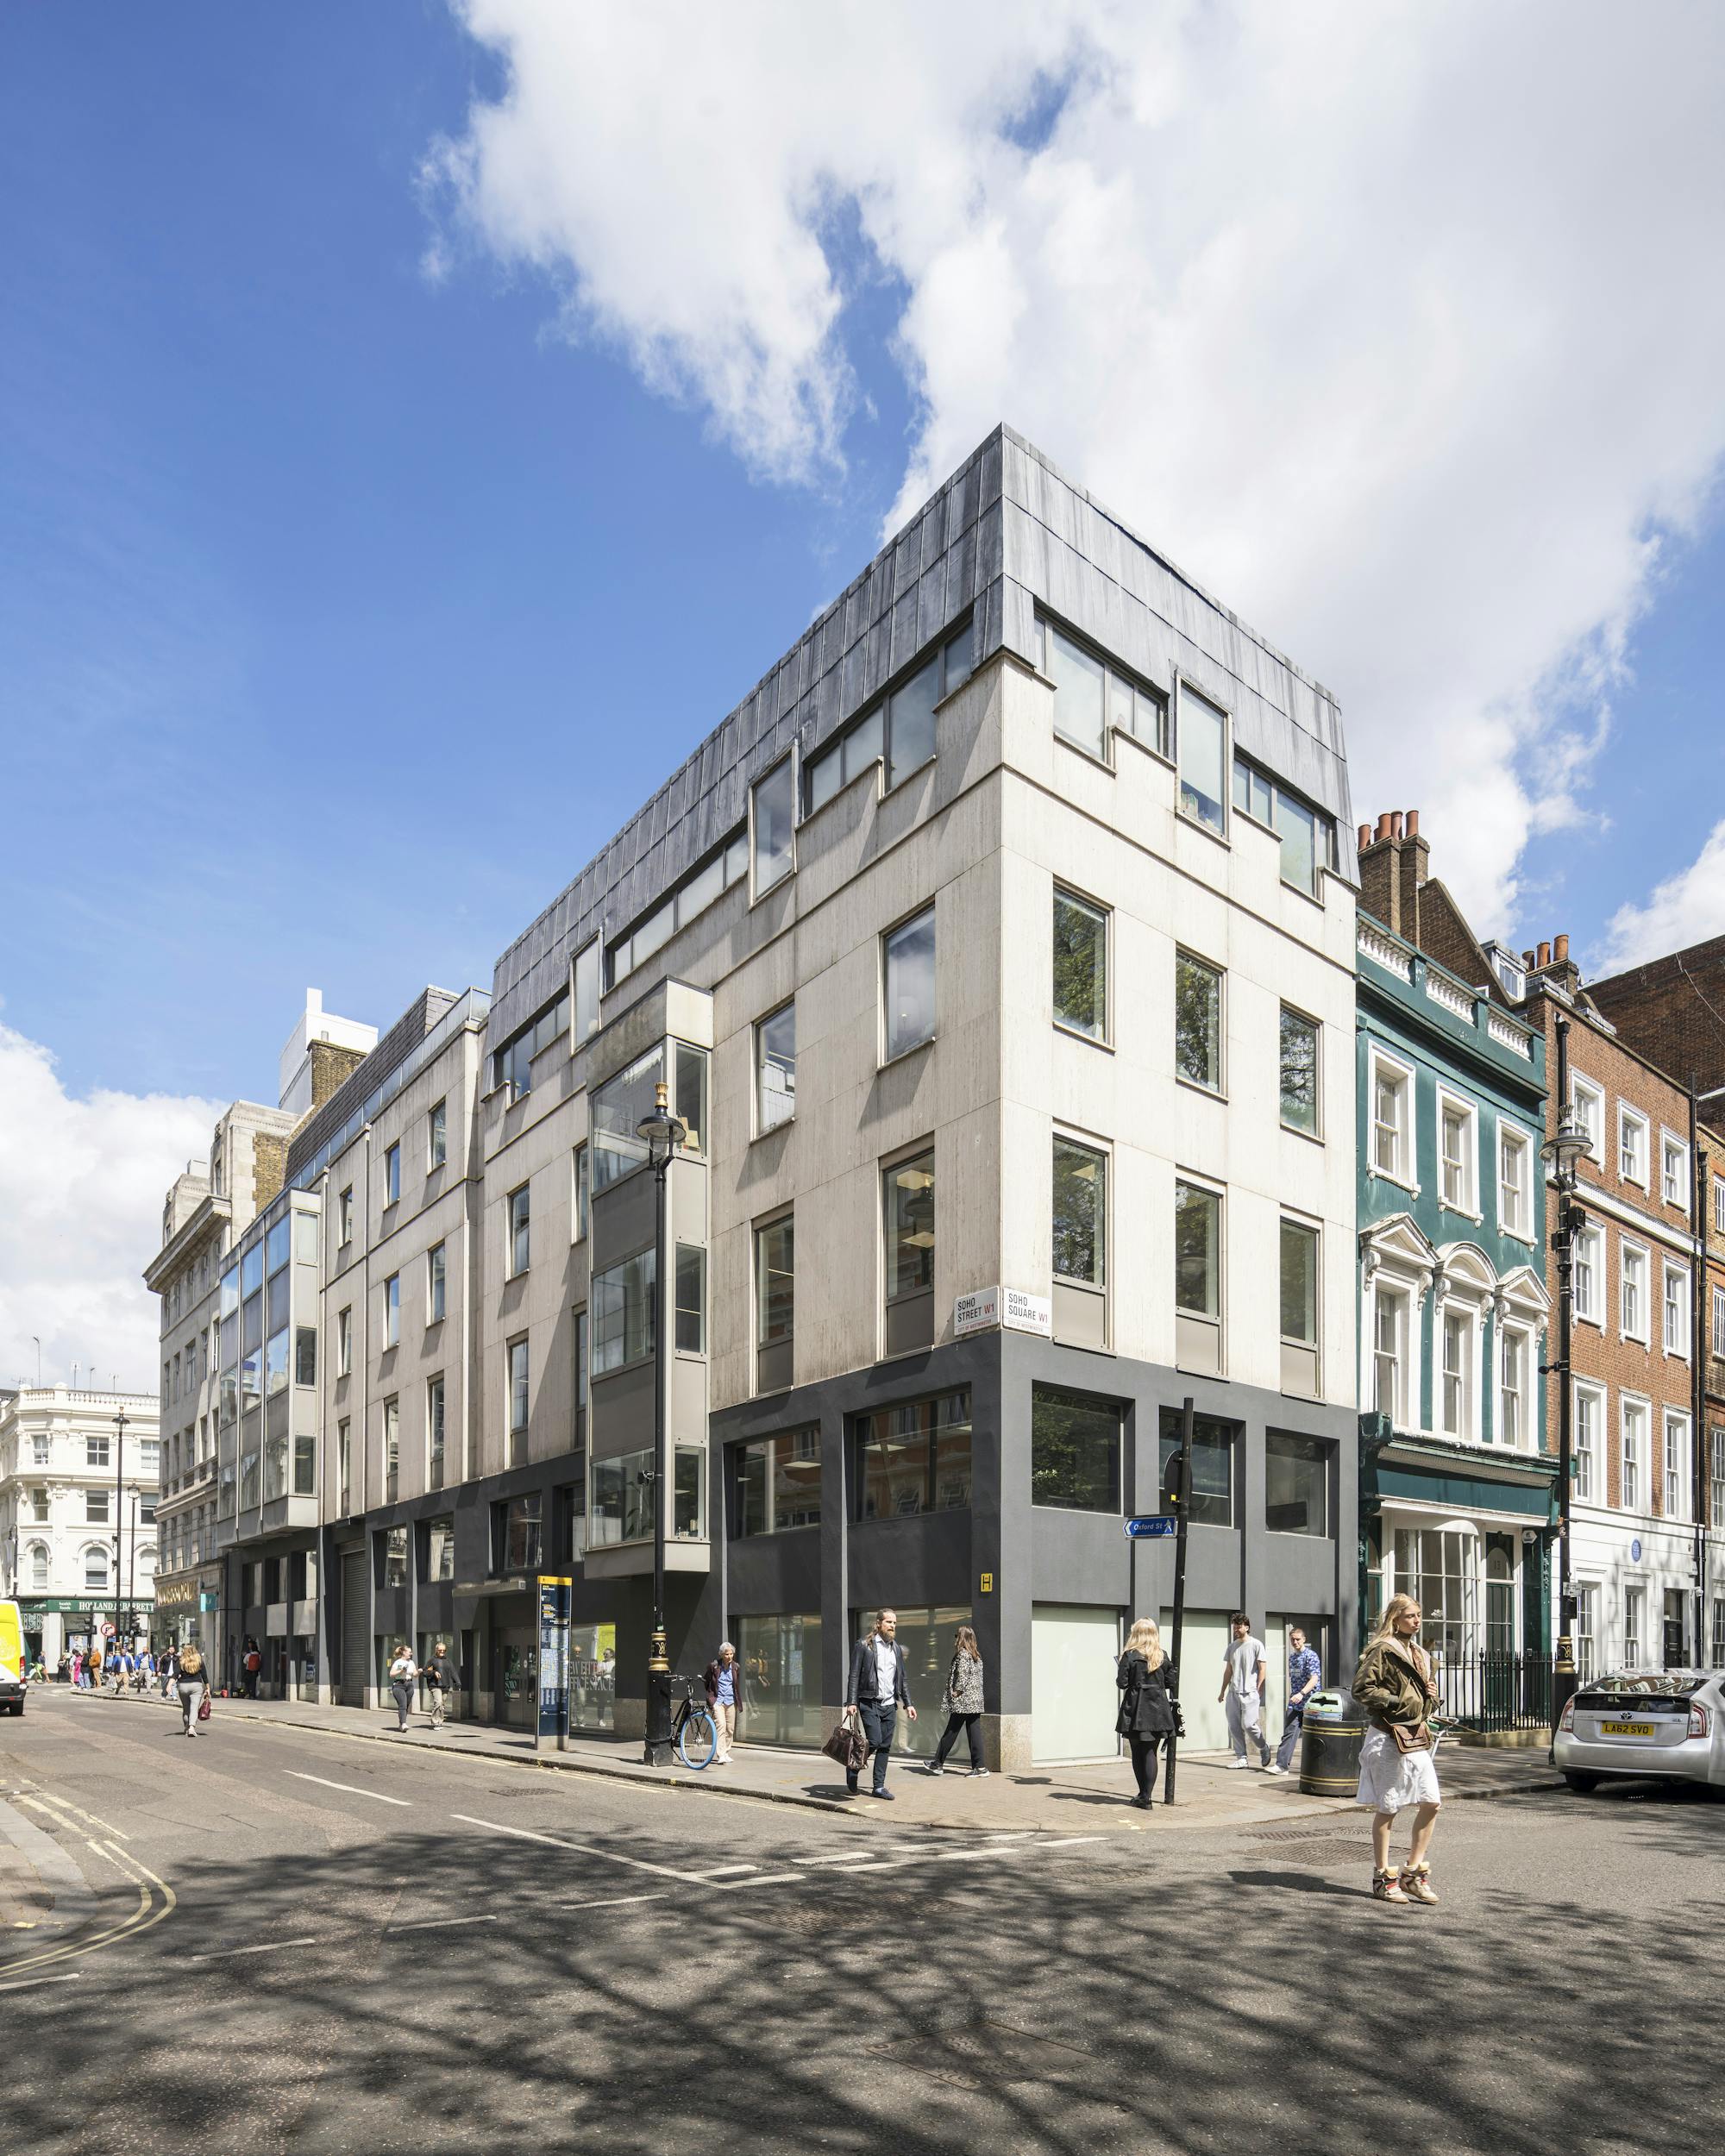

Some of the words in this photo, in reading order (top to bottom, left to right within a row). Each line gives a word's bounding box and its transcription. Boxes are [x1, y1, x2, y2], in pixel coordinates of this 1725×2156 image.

[957, 1297, 975, 1311] SOHO
[1009, 1294, 1027, 1306] SOHO
[957, 1307, 982, 1322] STREET
[984, 1303, 994, 1313] W1
[1008, 1305, 1036, 1320] SQUARE
[1038, 1313, 1048, 1323] W1
[983, 1575, 990, 1589] H
[569, 1676, 589, 1690] FFICE
[1605, 1725, 1628, 1733] LA62
